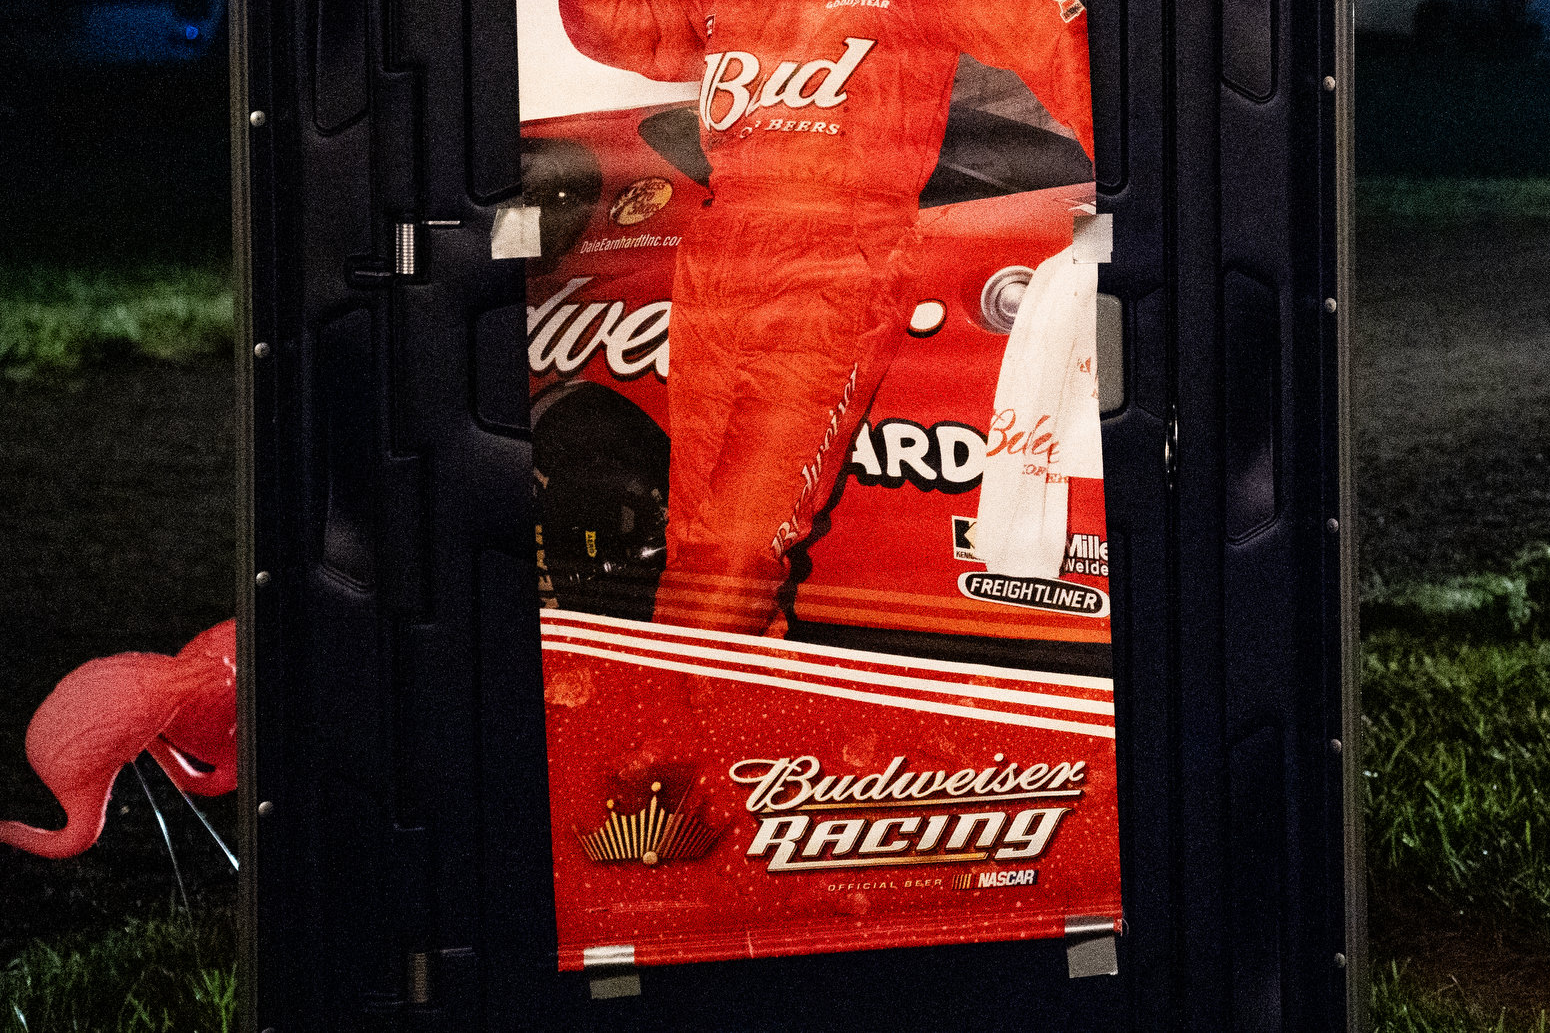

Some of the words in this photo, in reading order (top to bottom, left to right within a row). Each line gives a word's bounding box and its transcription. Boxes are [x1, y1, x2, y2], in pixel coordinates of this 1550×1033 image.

[699, 36, 878, 132] Bud
[764, 118, 841, 135] BEERS
[969, 577, 1098, 610] FREIGHTLINER
[729, 753, 1085, 812] Budweiser
[827, 881, 895, 892] OFFICIAL
[904, 878, 943, 888] BEER
[977, 870, 1037, 889] NASCAR
